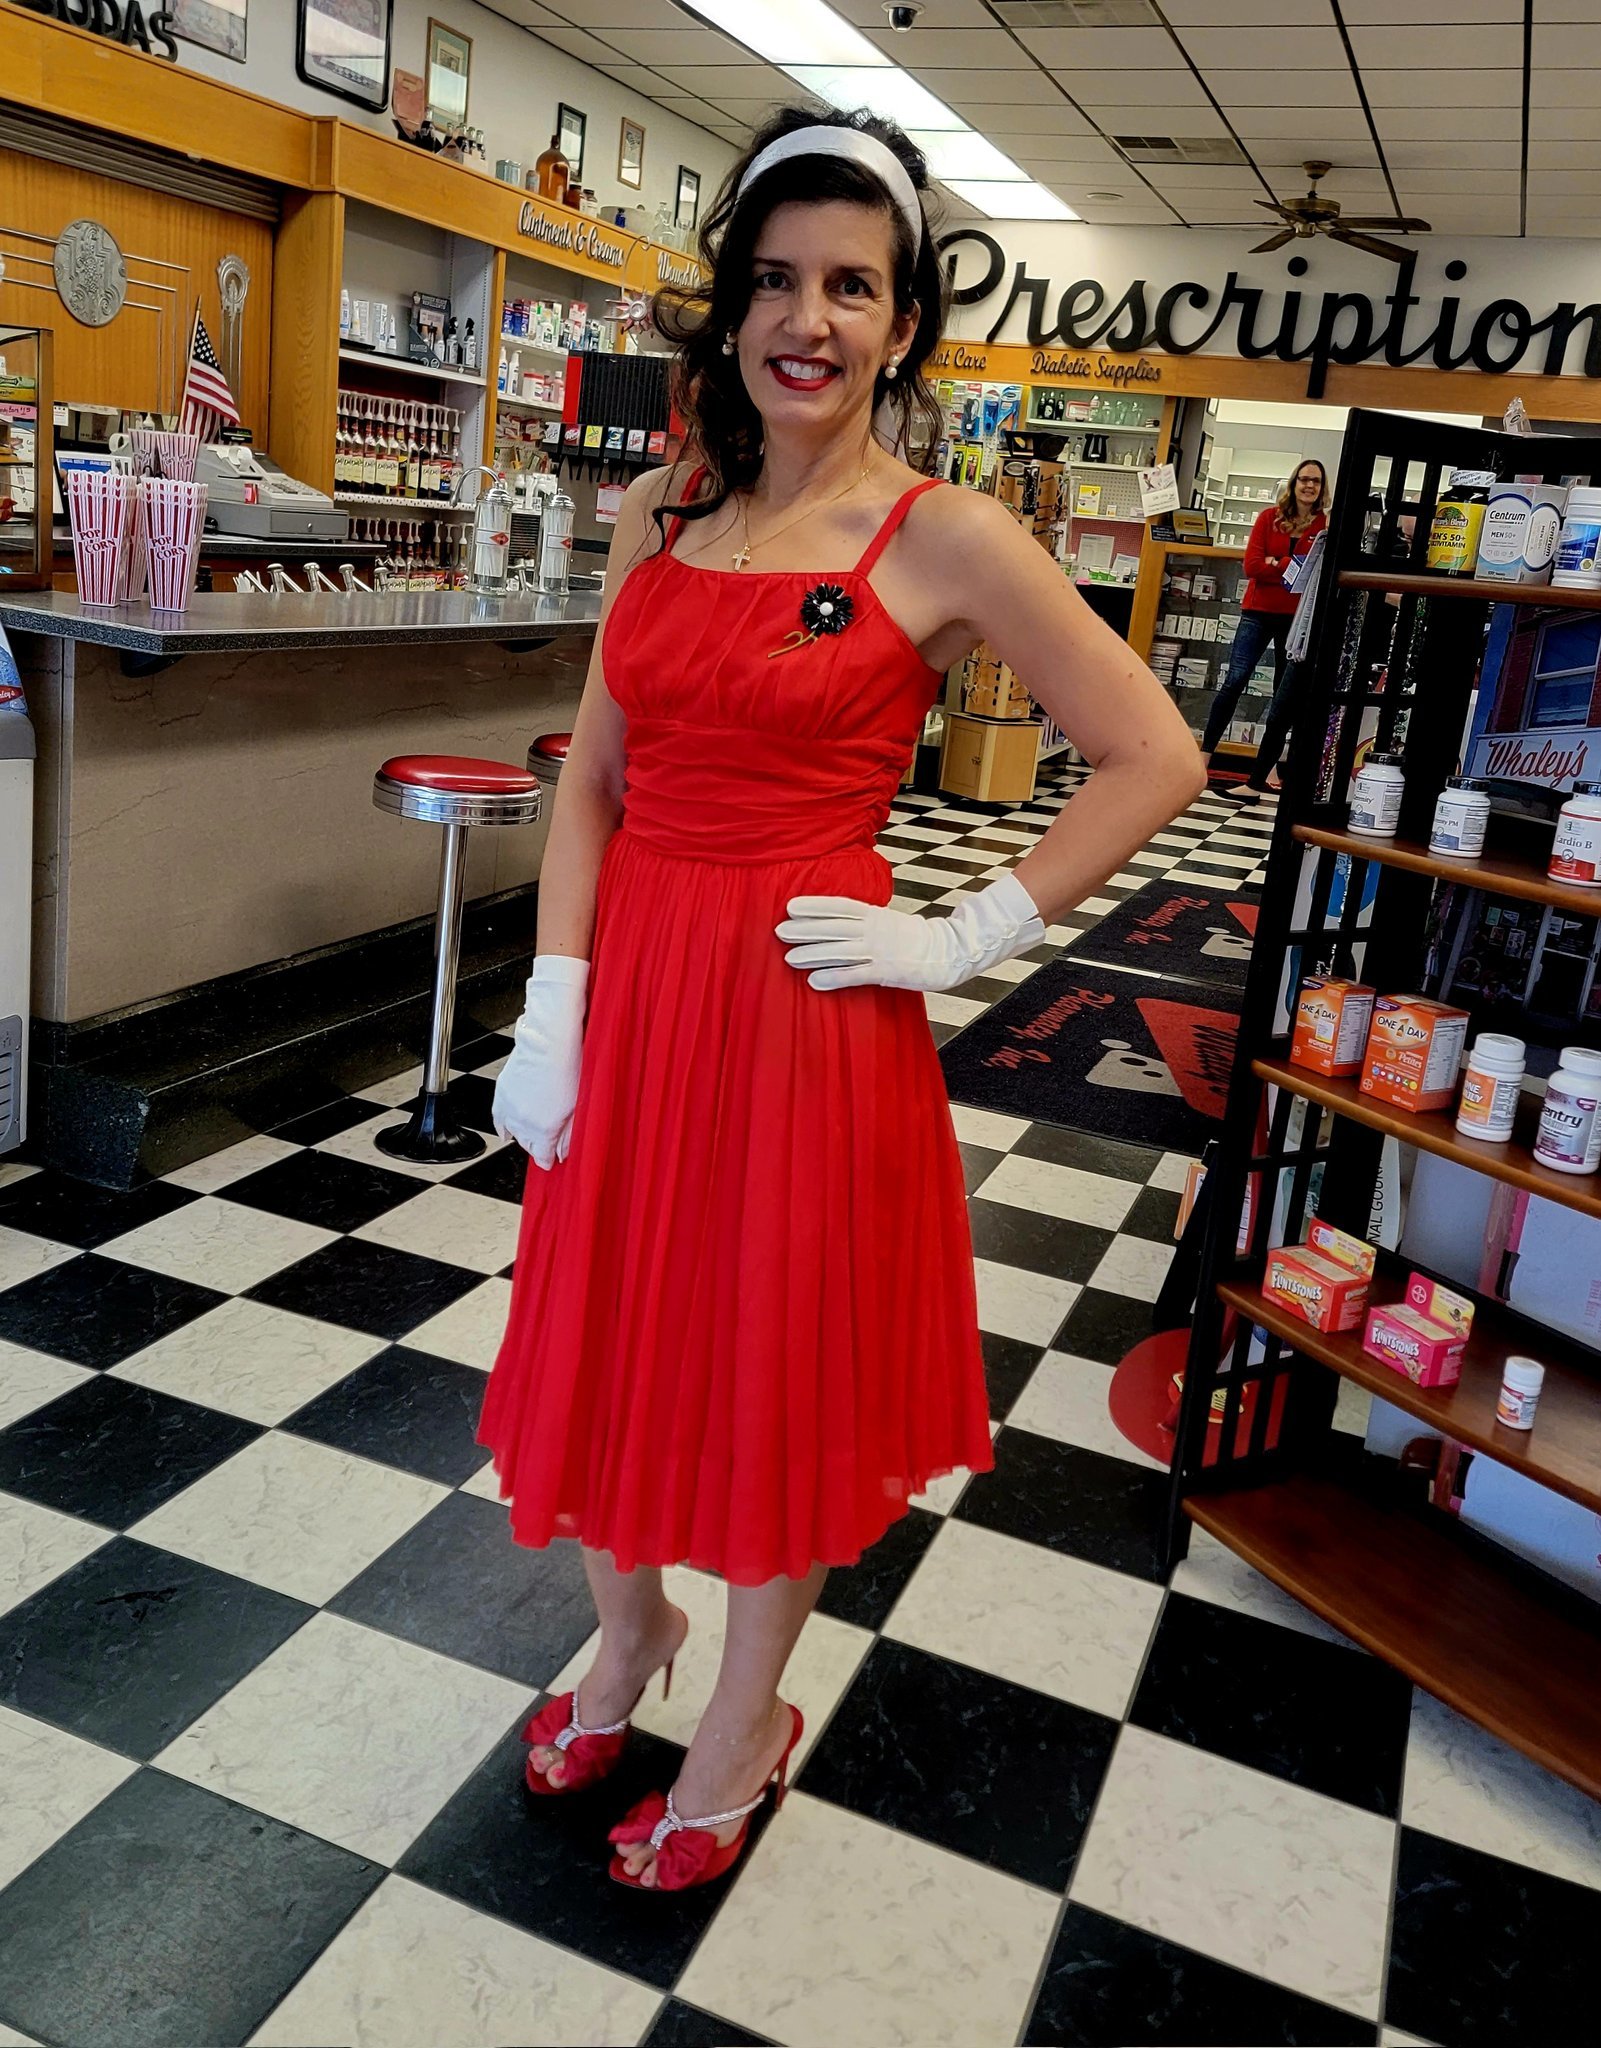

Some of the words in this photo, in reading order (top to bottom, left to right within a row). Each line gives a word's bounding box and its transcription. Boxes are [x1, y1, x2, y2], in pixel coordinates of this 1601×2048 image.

[28, 0, 178, 63] ODAS
[517, 199, 574, 252] Ointments
[573, 221, 588, 256] &
[587, 224, 626, 269] Creams
[657, 250, 692, 287] Wound
[954, 346, 987, 371] Care
[1030, 350, 1092, 379] Diabetic
[1094, 354, 1162, 388] Supplies
[1489, 510, 1526, 521] Centrum
[79, 529, 101, 541] POP
[85, 538, 116, 555] CORN
[151, 536, 172, 547] POP
[1431, 532, 1448, 541] EN'S
[1449, 533, 1467, 542] 50+
[1490, 531, 1505, 539] MEN
[1545, 520, 1558, 557] Centrum
[156, 545, 187, 561] CORN
[1485, 739, 1588, 789] Whaley's
[1585, 840, 1592, 849] B
[1300, 1002, 1315, 1014] ONE
[1321, 1010, 1337, 1021] DAY
[1377, 1016, 1398, 1030] ONE
[1397, 1023, 1404, 1032] A
[1406, 1026, 1427, 1040] DAY
[1543, 1106, 1584, 1129] entry
[1271, 1270, 1322, 1301] FLINTSTONES
[1371, 1326, 1419, 1357] FLINTSTONES
